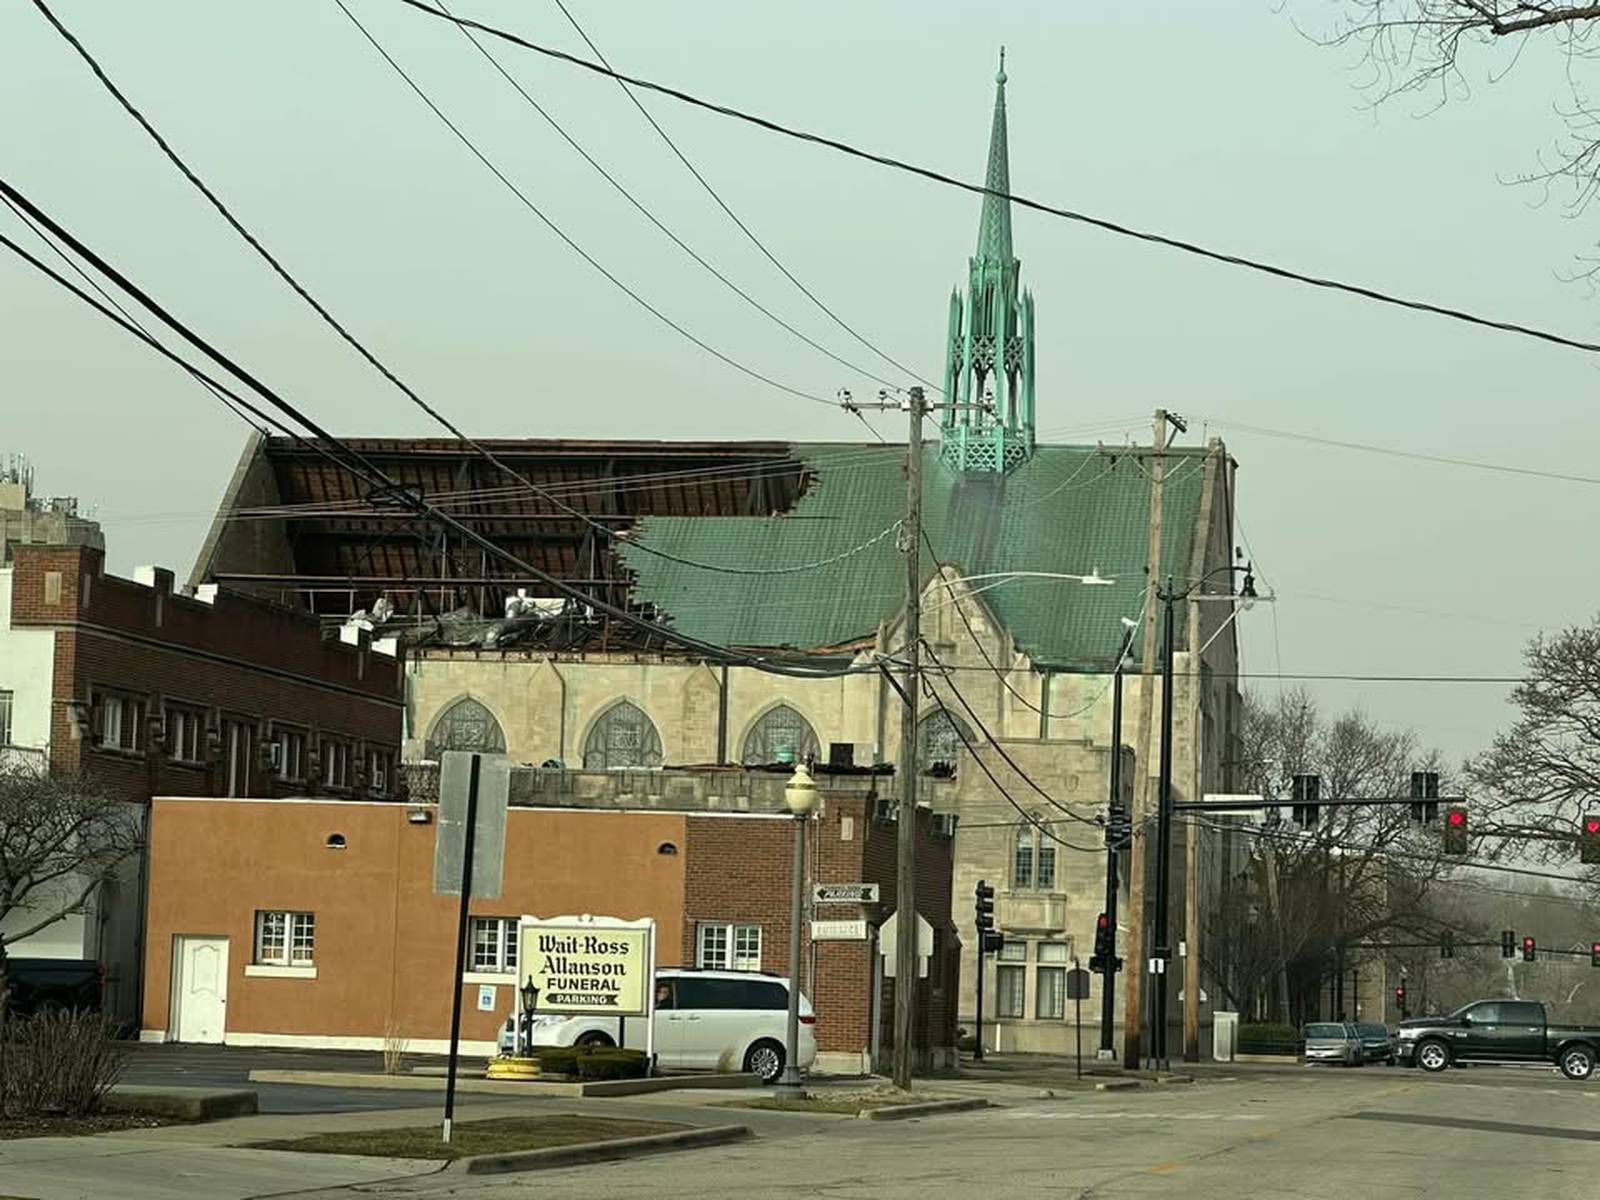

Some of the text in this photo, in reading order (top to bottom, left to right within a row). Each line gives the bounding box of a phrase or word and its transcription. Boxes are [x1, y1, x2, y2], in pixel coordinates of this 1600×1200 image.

[539, 935, 630, 955] Wait-Ross
[539, 955, 626, 976] Allanson
[547, 978, 621, 991] FUNERAL
[556, 994, 608, 1004] PARKING
